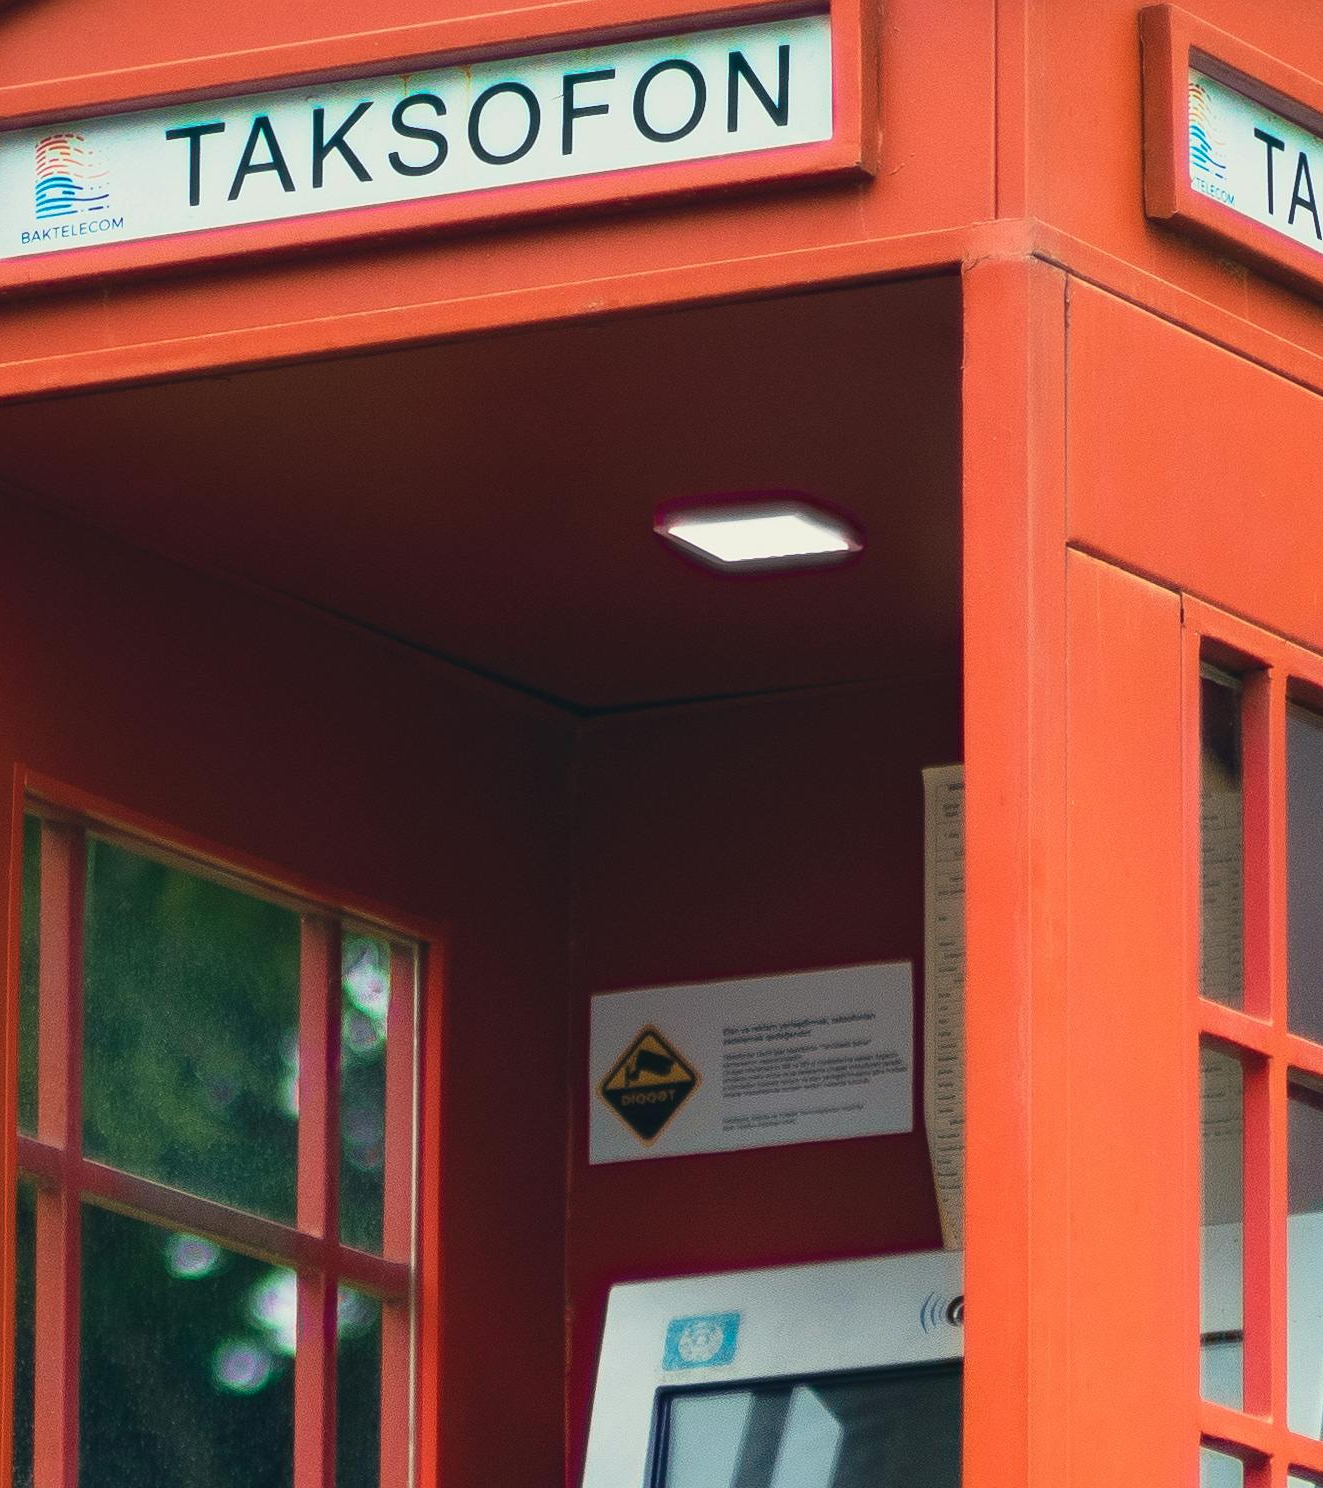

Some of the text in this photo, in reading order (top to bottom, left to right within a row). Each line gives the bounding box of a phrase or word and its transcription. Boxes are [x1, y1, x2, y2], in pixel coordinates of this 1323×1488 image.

[165, 43, 791, 208] TAKSOFON
[1190, 176, 1236, 205] TELECOM
[20, 216, 124, 245] BAKTELECOM
